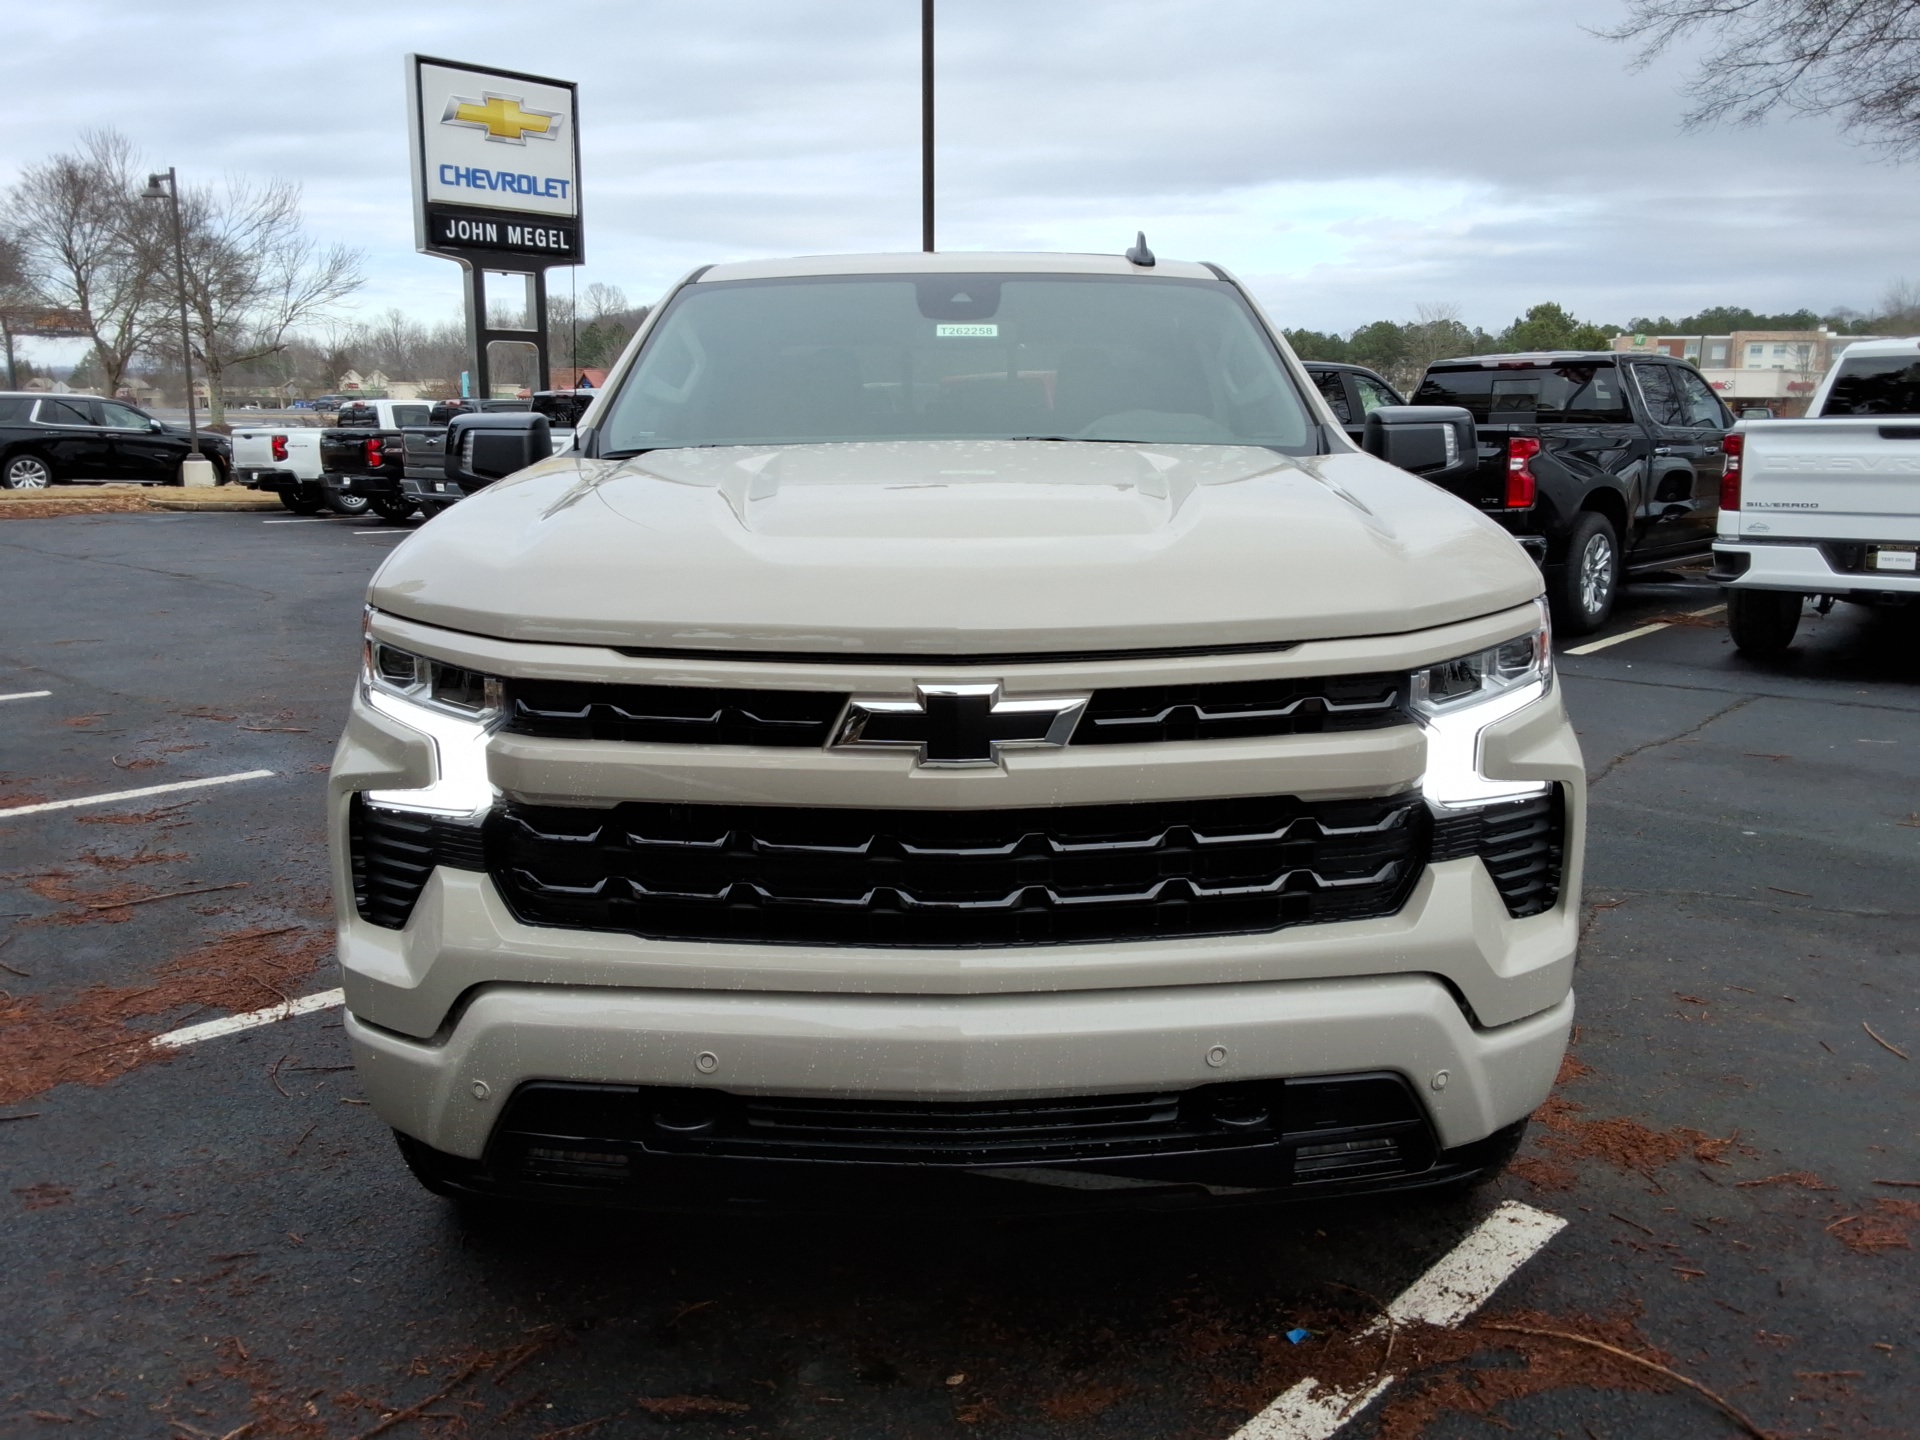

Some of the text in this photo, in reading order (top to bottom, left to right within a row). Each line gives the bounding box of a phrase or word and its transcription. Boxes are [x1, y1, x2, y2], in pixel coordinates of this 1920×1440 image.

[439, 163, 570, 199] CHEVROLET
[445, 219, 570, 250] JOHN MEGEL
[940, 327, 993, 335] T262258
